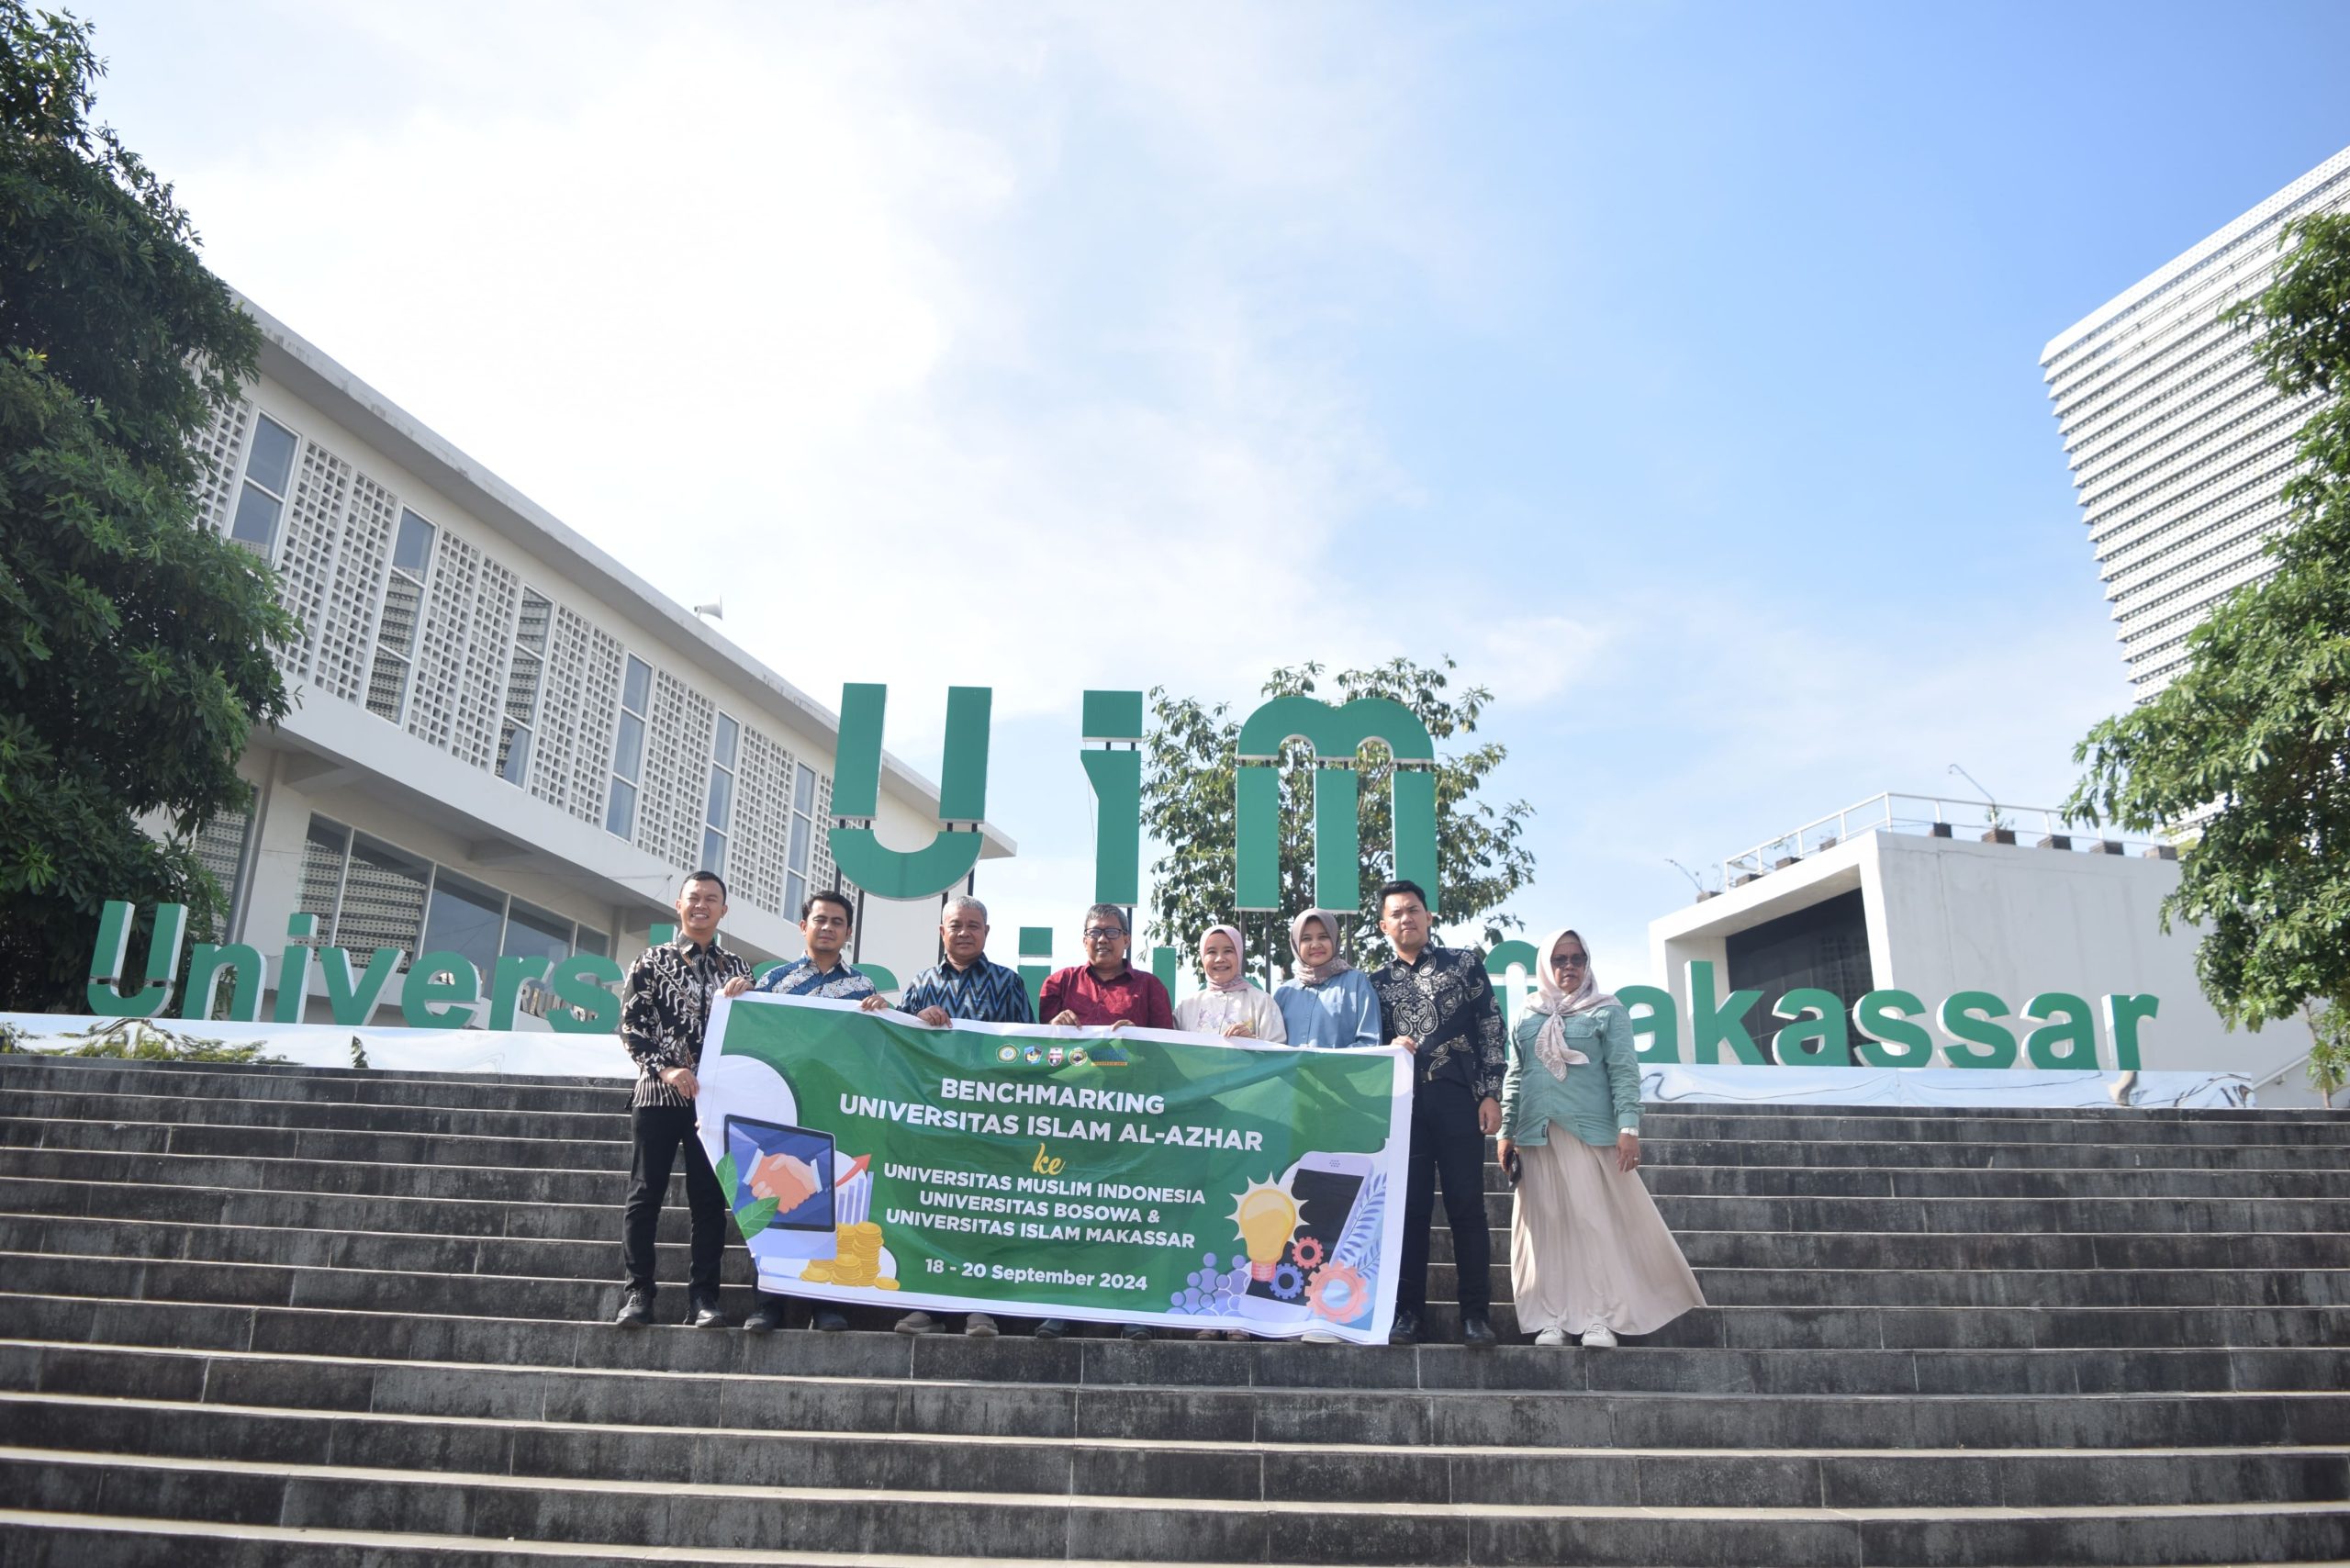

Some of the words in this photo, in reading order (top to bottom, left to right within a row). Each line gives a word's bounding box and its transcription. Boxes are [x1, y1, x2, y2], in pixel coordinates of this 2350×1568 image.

[87, 900, 900, 1035] Univers
[941, 1078, 1165, 1114] BENCHMARKING
[839, 1092, 1019, 1135] UNIVERSITAS
[1027, 1115, 1111, 1142] ISLAM
[1118, 1123, 1263, 1151] AL-AZHAR
[1032, 1141, 1066, 1176] ke
[884, 1162, 1012, 1191] UNIVERSITAS
[1016, 1176, 1092, 1197] MUSLIM
[1097, 1182, 1205, 1204] INDONESIA
[920, 1190, 1048, 1217] UNIVERSITAS
[1054, 1203, 1142, 1223] BOSOWA
[1147, 1209, 1160, 1224] &
[886, 1208, 1015, 1237] UNIVERSITAS
[1020, 1222, 1080, 1241] ISLAM
[1085, 1227, 1195, 1249] MAKASSAR
[925, 1258, 944, 1273] 18
[961, 1262, 987, 1278] 20
[991, 1265, 1094, 1286] September
[1099, 1272, 1148, 1291] 2024
